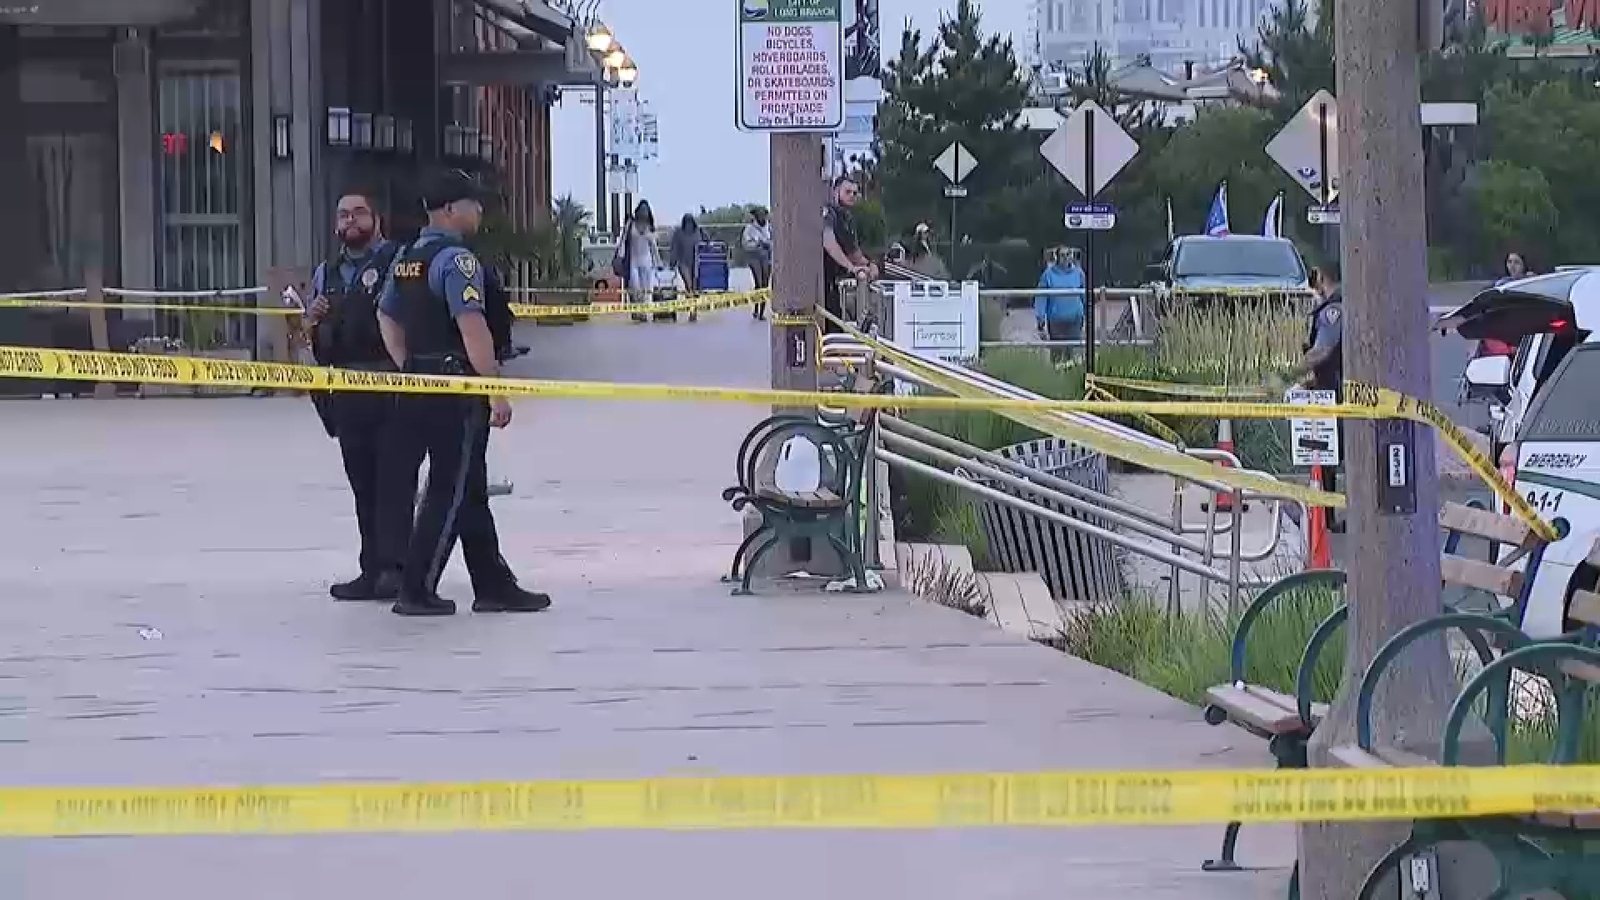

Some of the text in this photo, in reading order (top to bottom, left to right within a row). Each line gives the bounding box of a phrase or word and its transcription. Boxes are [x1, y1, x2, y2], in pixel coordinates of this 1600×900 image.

[774, 6, 837, 17] LONG BRANCH
[768, 26, 814, 38] NO DOGS,
[766, 39, 816, 50] BICYCLES,
[753, 51, 829, 63] HOVERBOARDS,
[751, 64, 831, 75] ROLLERBLADES,
[748, 76, 836, 88] OR SKATEBOARDS
[755, 90, 827, 100] PERMITTED ON
[761, 103, 823, 113] PROMENADE
[758, 116, 772, 126] City
[394, 261, 423, 278] OLICE
[68, 354, 100, 376] POLICE
[203, 361, 235, 381] POLICE
[1350, 381, 1379, 408] CROSS
[1524, 453, 1588, 468] EMERGENCY
[1527, 491, 1564, 513] 9-1-1
